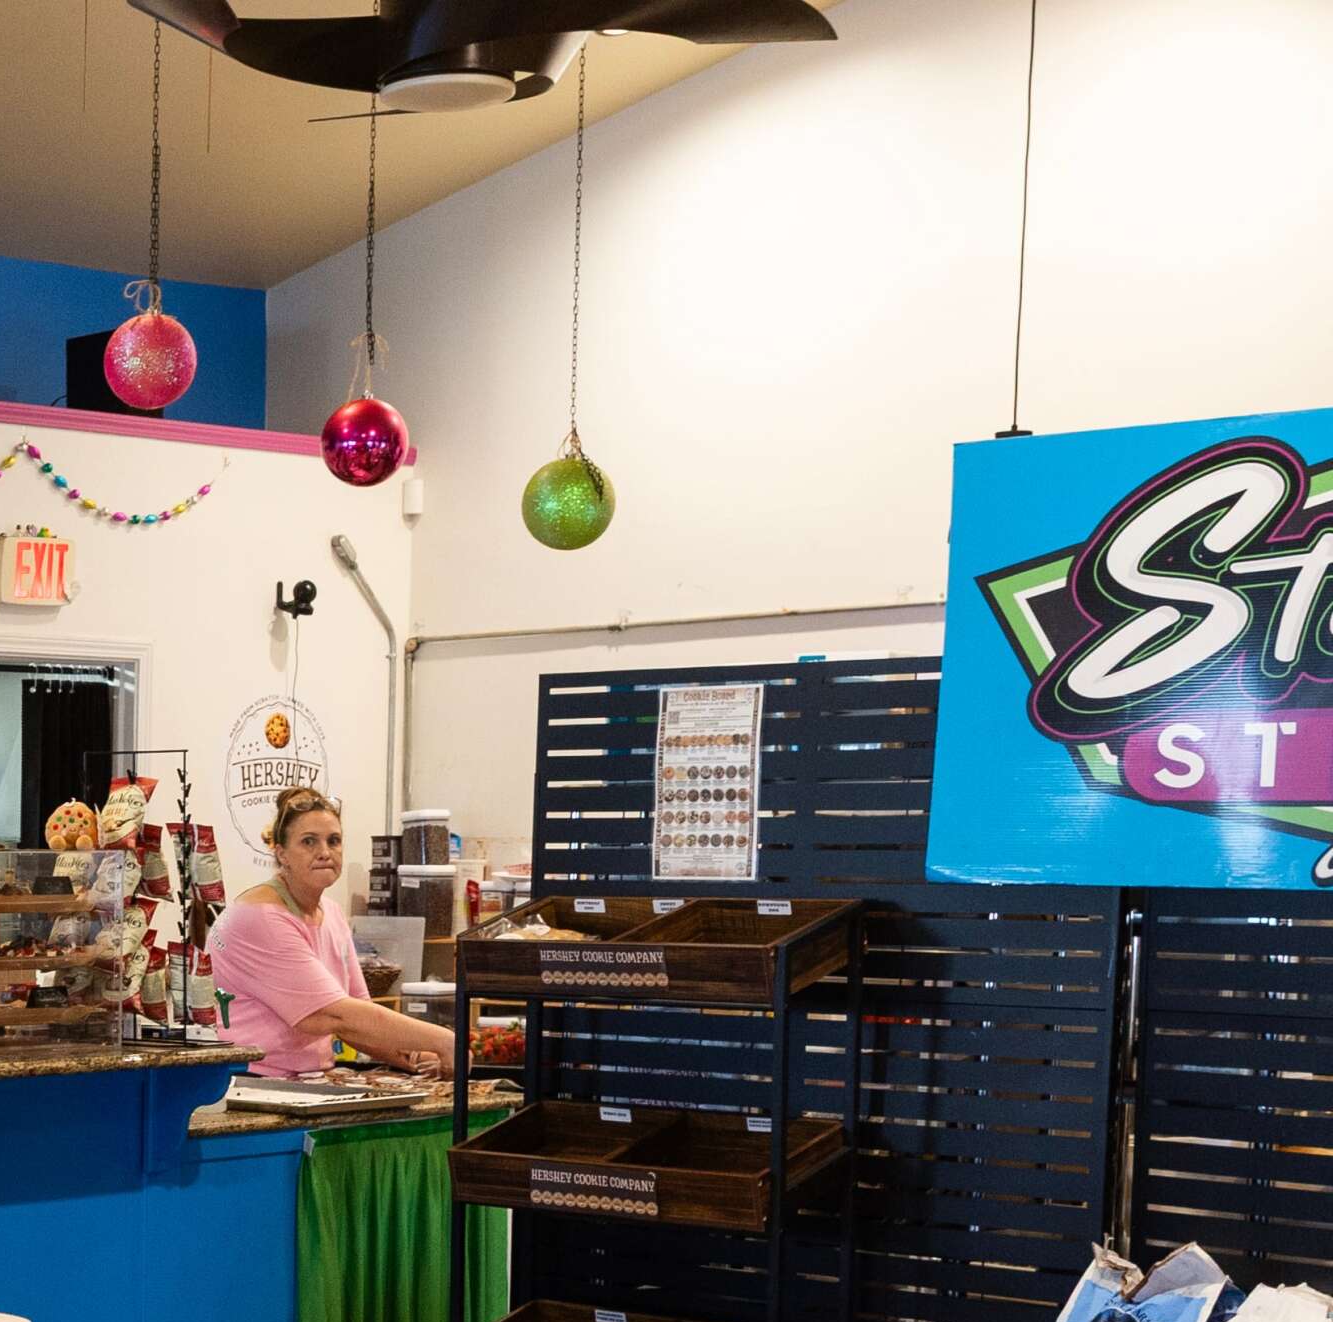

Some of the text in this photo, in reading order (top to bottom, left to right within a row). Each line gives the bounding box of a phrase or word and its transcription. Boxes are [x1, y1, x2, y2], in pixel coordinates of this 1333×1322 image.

[14, 541, 69, 601] EXIT
[241, 761, 320, 790] HERSHEY
[540, 949, 664, 965] HERSHEY COOKIE COMPANY
[531, 1168, 656, 1193] HERSHEY COOKIE COMPANY
